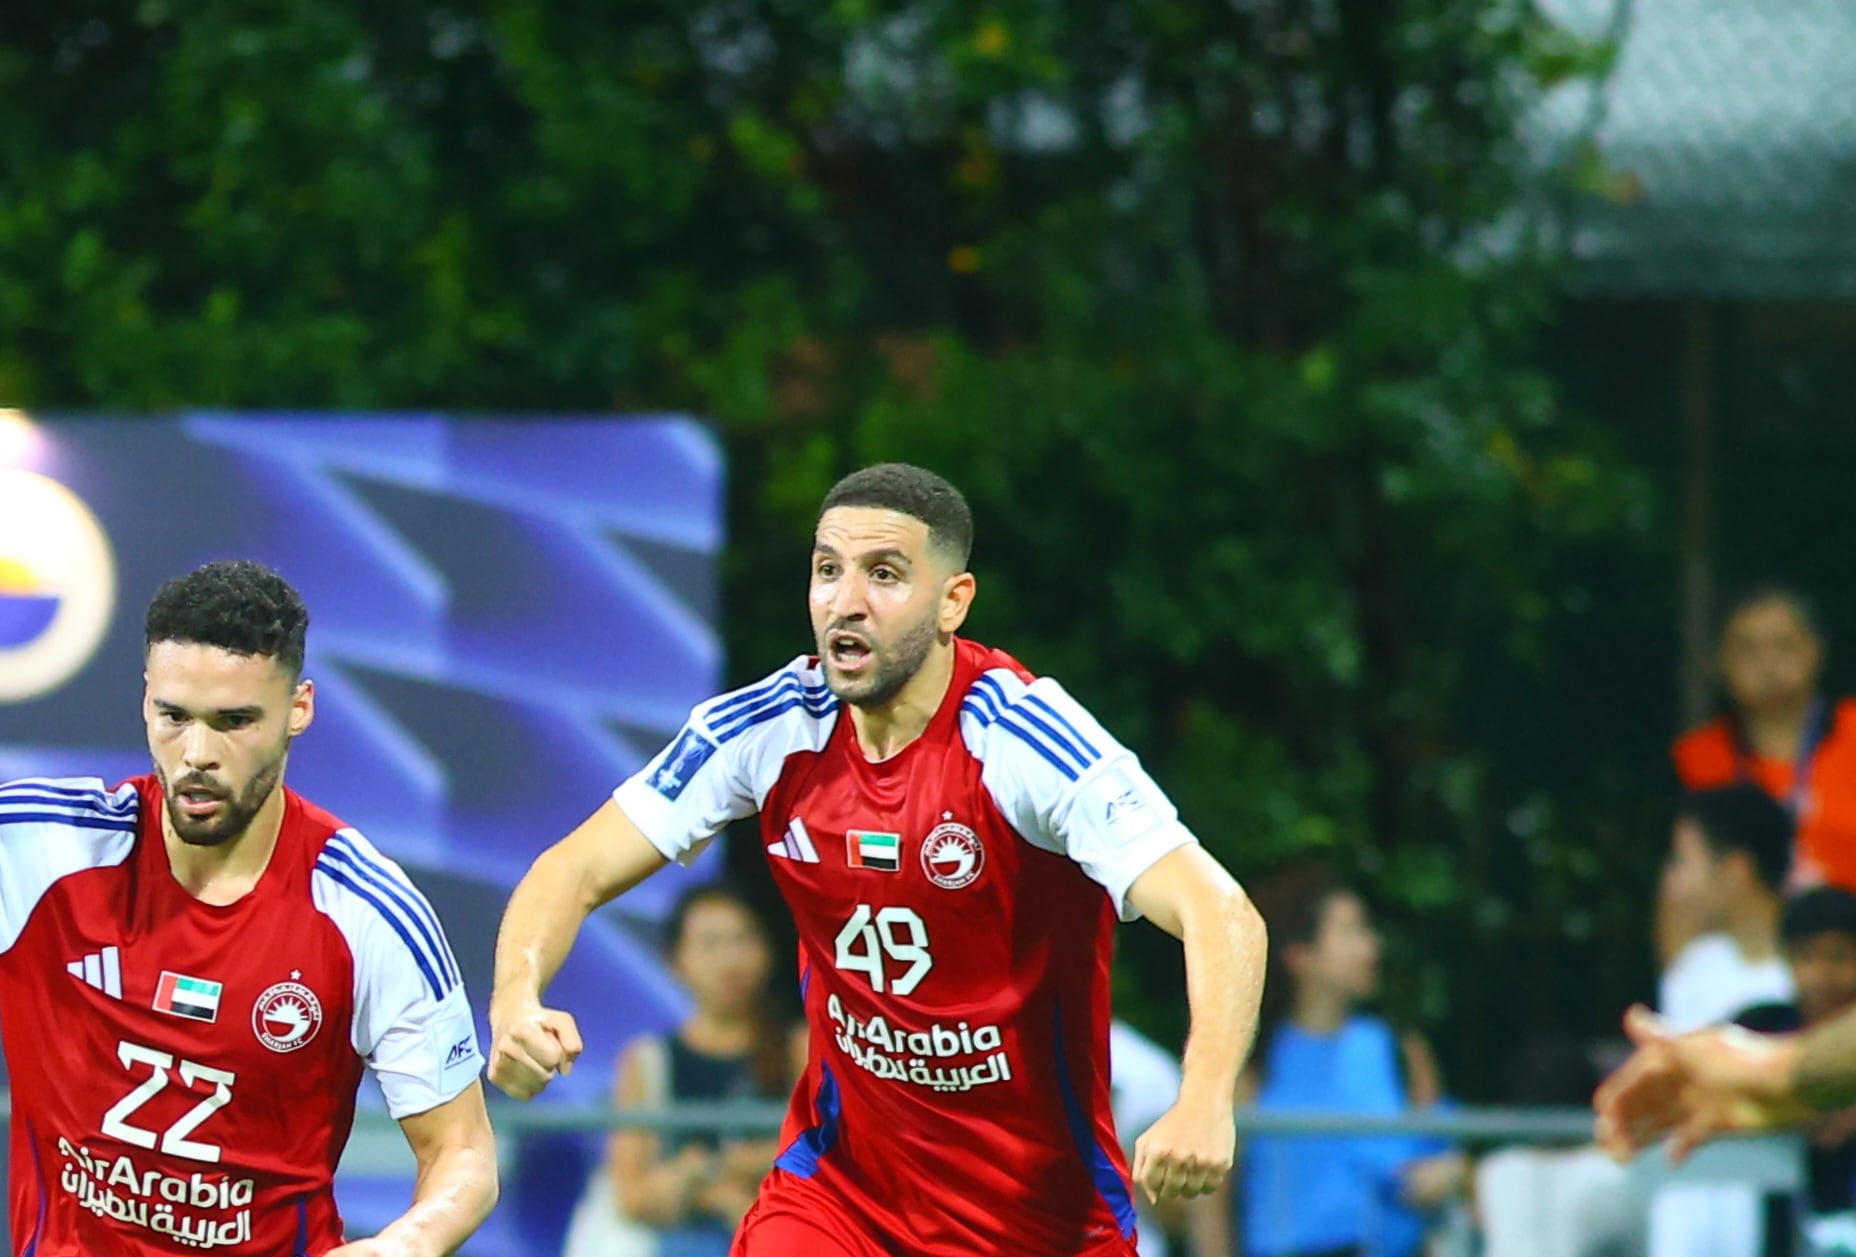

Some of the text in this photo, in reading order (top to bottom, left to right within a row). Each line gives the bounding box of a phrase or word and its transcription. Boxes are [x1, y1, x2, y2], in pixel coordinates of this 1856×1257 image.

[835, 903, 933, 996] 49
[445, 1033, 473, 1065] AFC
[908, 1051, 1012, 1092] العربية
[101, 1040, 236, 1163] 22
[61, 1162, 251, 1249] العربية للطيران
